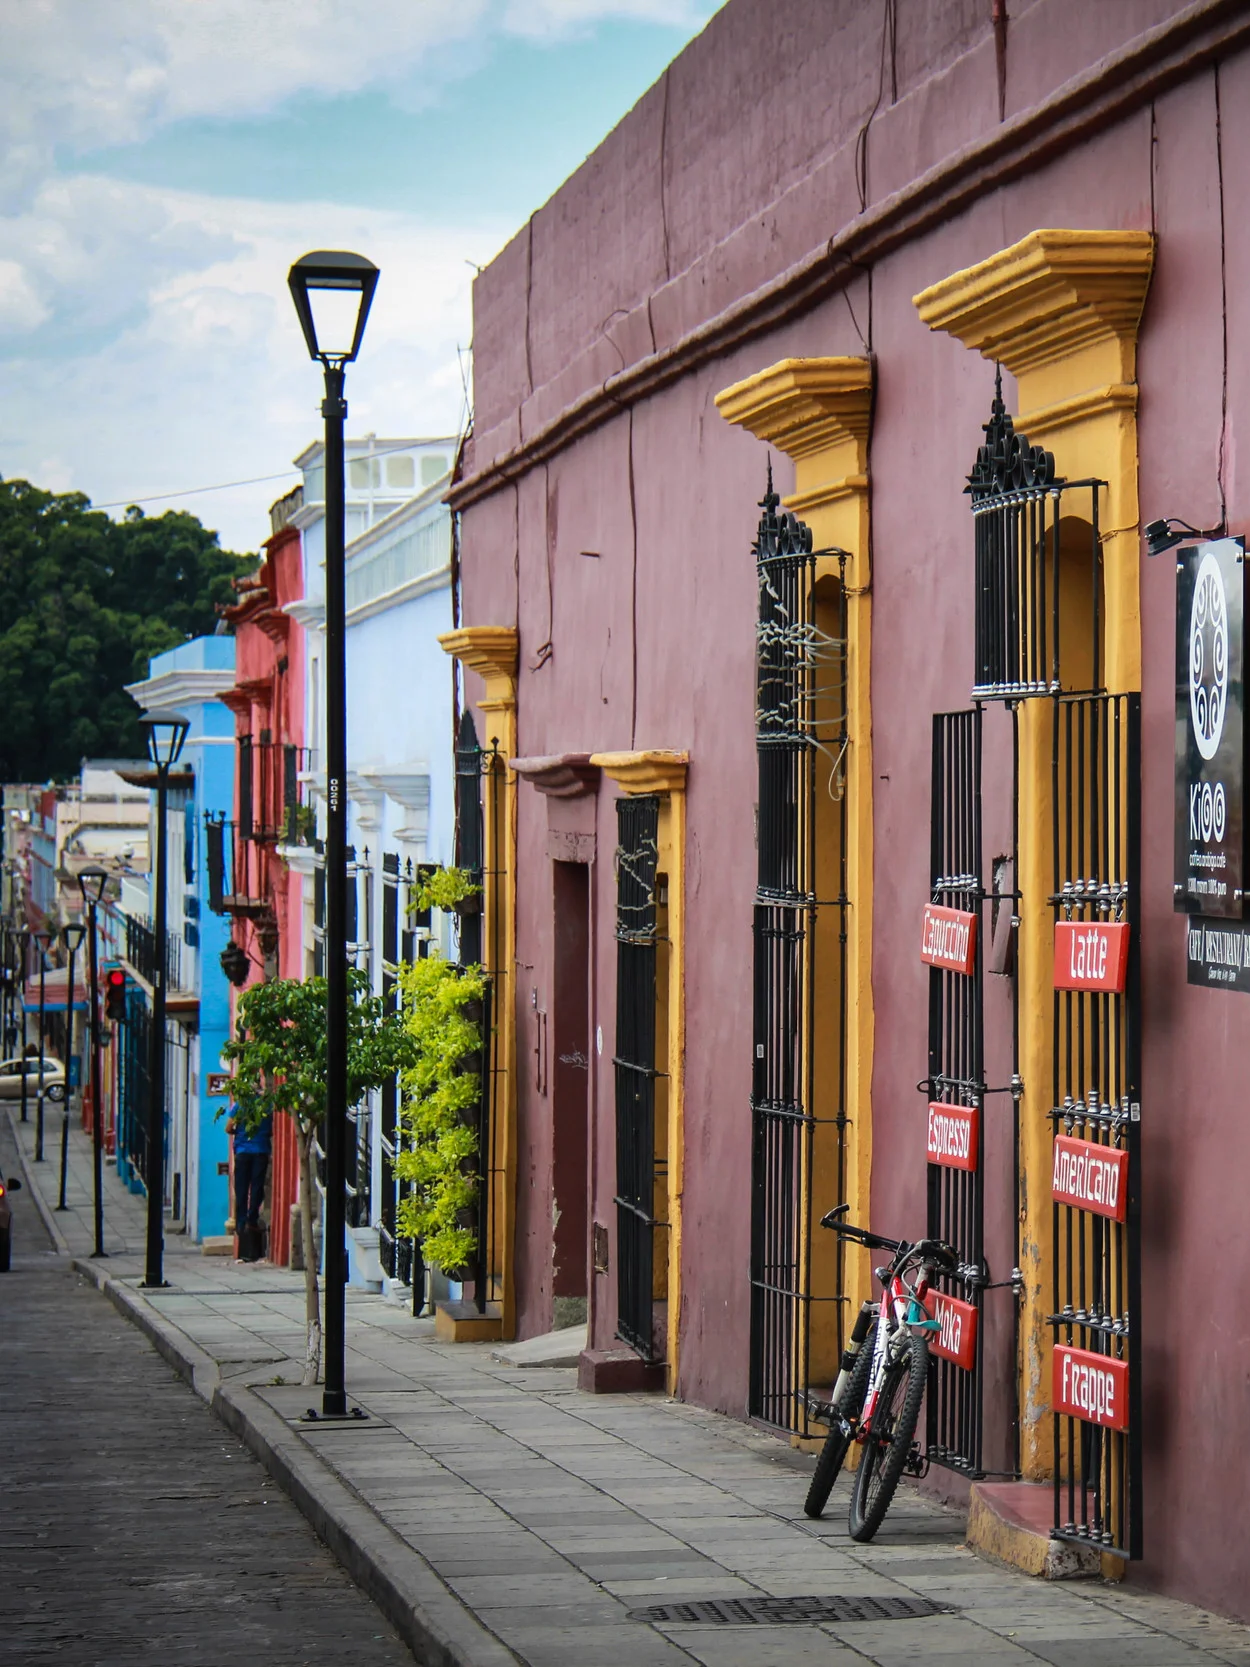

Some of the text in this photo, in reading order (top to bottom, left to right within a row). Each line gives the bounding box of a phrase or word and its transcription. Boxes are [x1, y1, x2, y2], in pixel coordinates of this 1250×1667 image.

[330, 778, 339, 812] 00261
[922, 909, 970, 963] Capuccino
[927, 1107, 970, 1160] Espresso
[1052, 1142, 1120, 1208] Americano
[932, 1297, 962, 1355] Moka
[1062, 1353, 1115, 1422] Frappe
